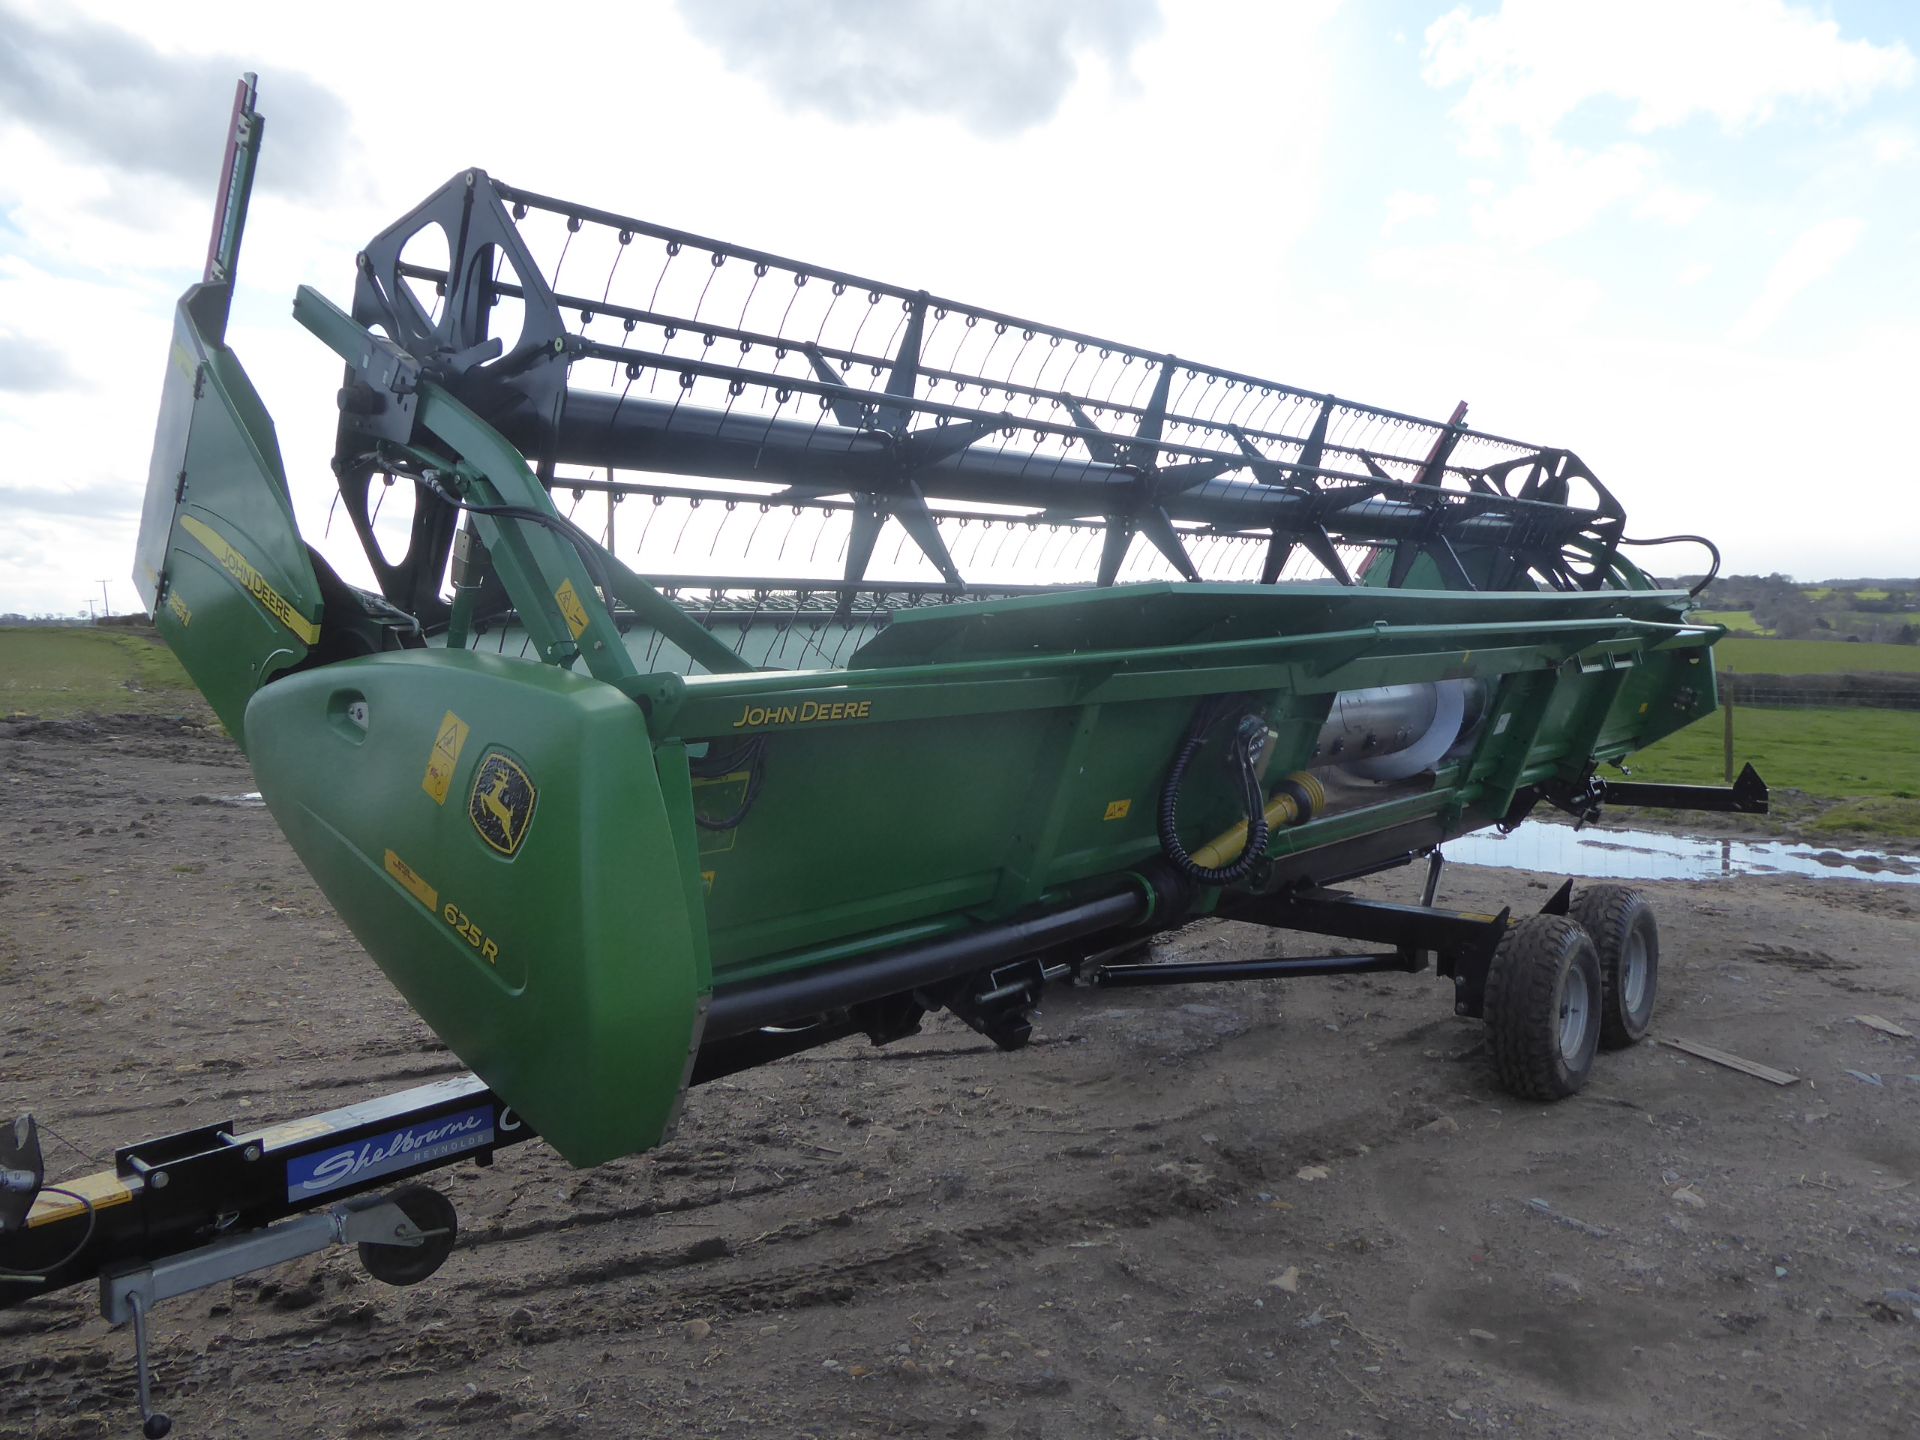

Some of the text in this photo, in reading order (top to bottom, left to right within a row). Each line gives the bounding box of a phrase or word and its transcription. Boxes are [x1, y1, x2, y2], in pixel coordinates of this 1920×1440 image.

[220, 547, 291, 624] JOHN DEERE
[733, 701, 872, 727] JOHN DEERE
[303, 1114, 482, 1190] Shelbourne
